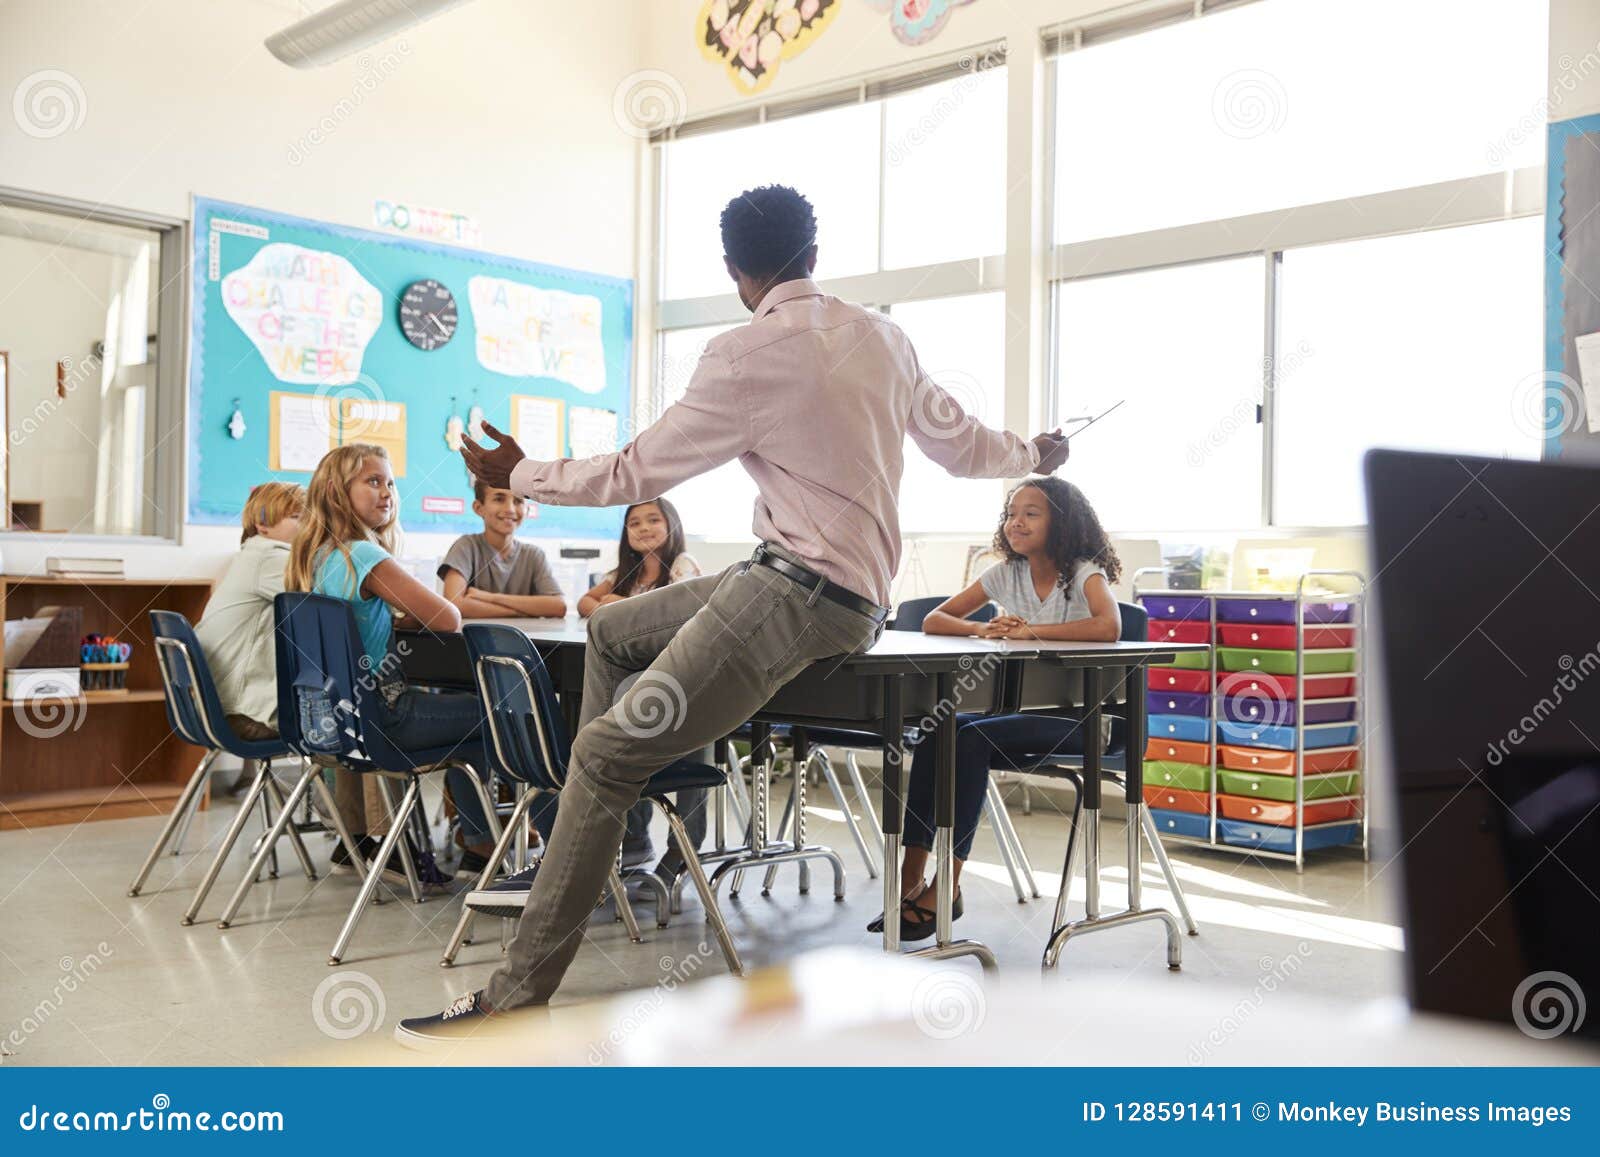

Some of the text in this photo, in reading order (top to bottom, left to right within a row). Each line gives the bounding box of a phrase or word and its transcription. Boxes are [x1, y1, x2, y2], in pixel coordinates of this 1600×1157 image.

[228, 279, 379, 320] CHALEG
[258, 311, 296, 342] OF
[273, 345, 351, 377] WEEK
